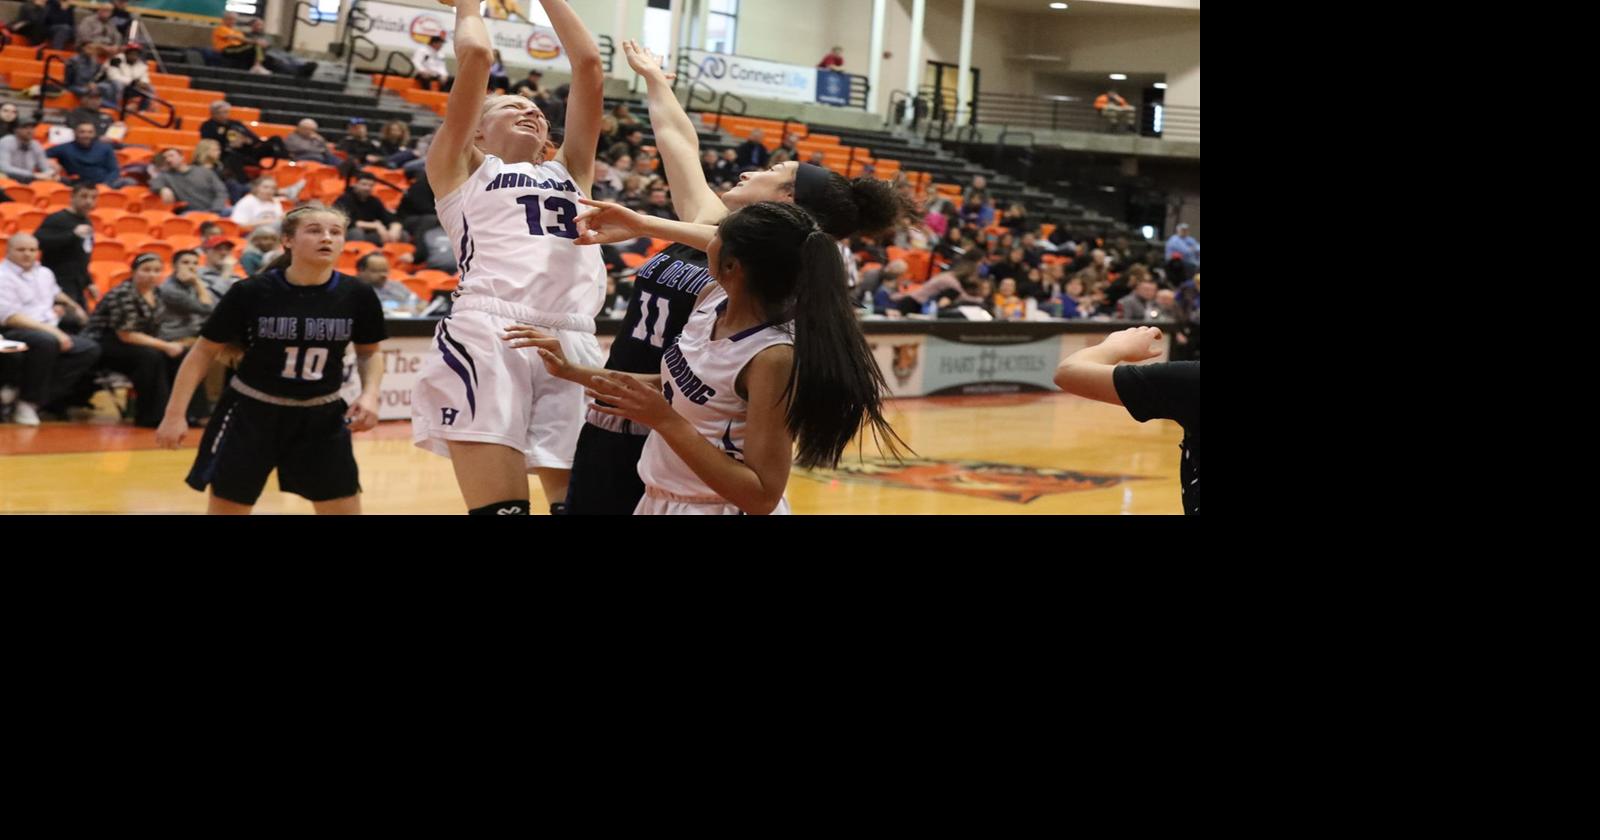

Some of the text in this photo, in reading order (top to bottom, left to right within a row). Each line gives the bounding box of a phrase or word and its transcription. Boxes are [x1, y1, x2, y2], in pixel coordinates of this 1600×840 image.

[516, 194, 580, 240] 13
[257, 316, 298, 340] BLUE
[631, 290, 670, 348] 11
[281, 346, 329, 381] 10
[381, 348, 421, 373] The
[664, 342, 716, 405] MBURG
[440, 407, 460, 426] H
